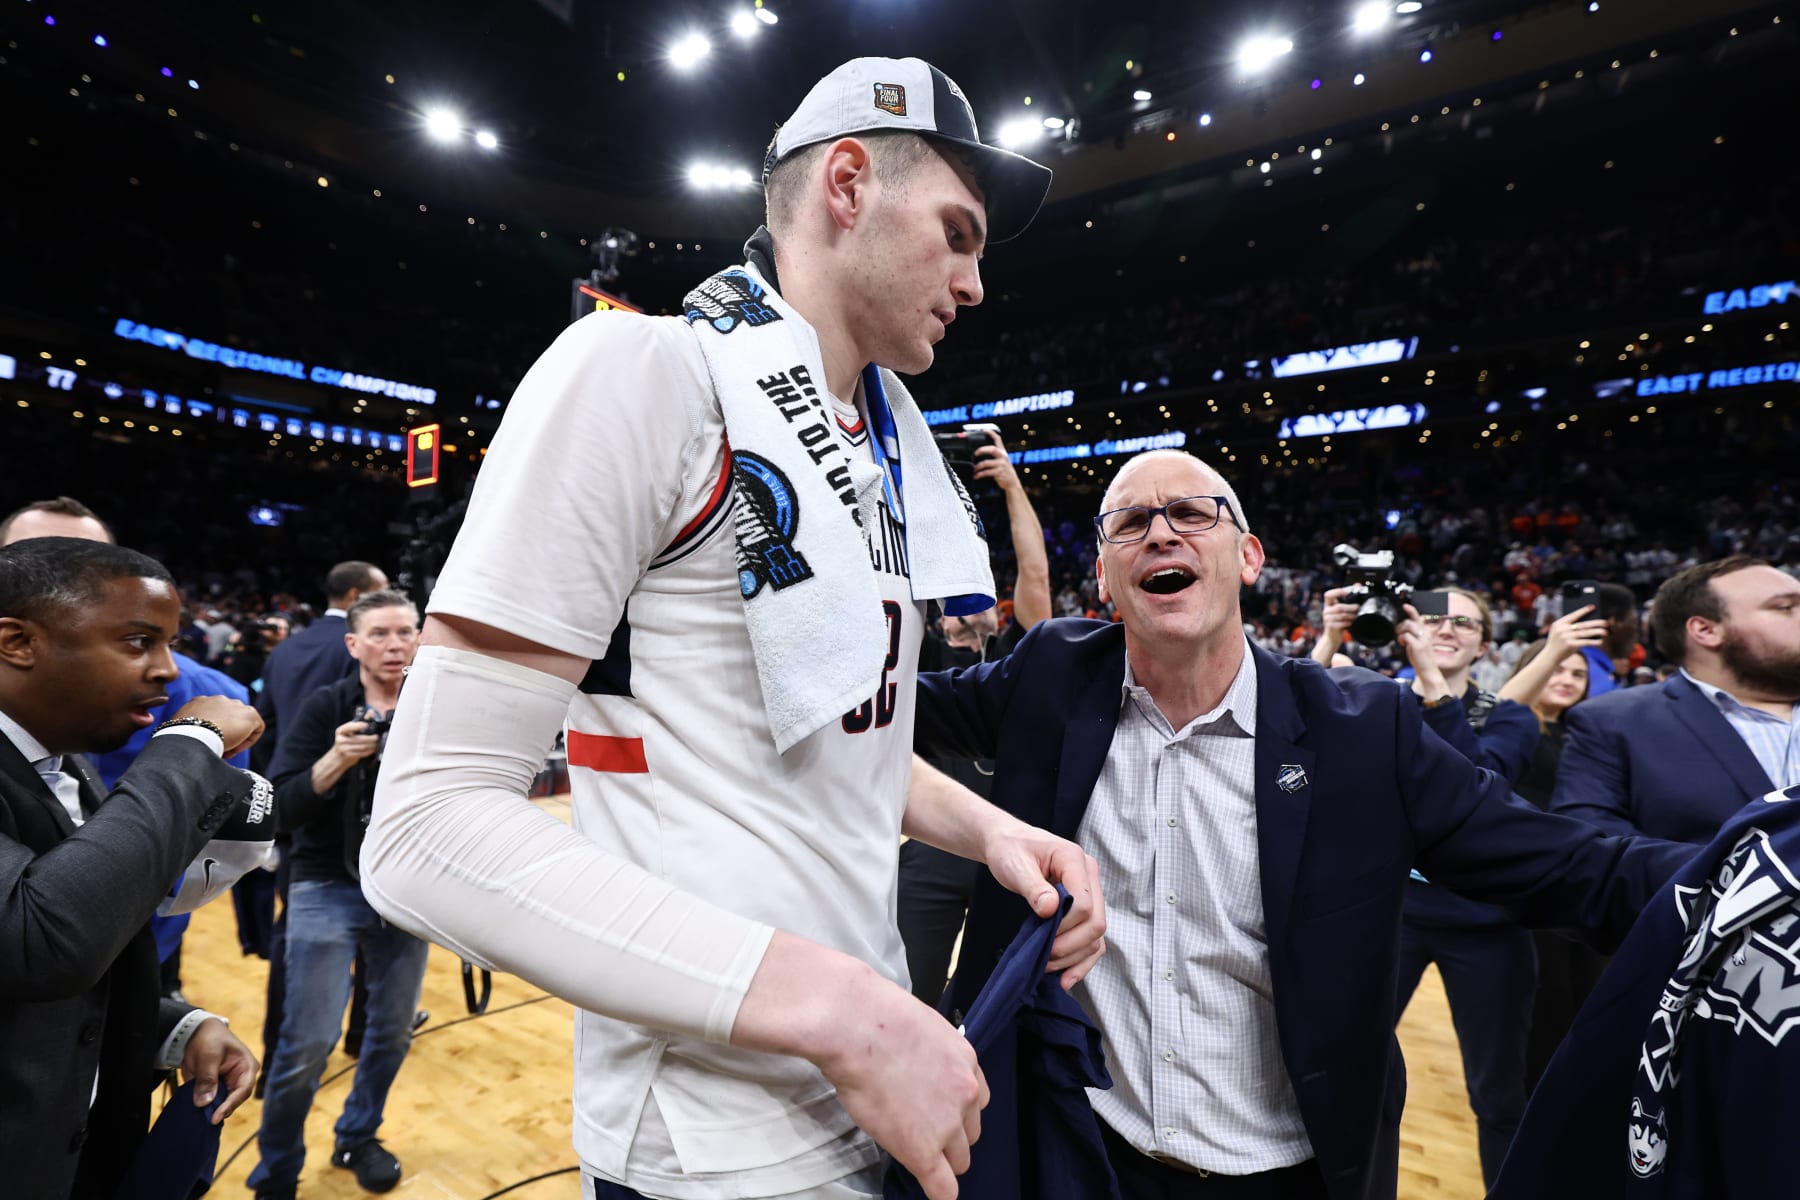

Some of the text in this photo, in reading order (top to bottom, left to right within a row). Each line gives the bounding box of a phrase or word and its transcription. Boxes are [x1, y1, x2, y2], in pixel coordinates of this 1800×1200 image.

[879, 89, 899, 97] FINAL
[879, 96, 899, 104] FOUR
[1704, 281, 1796, 314] EAST
[115, 318, 437, 405] EAST REGIONAL CHAMPIONS
[46, 366, 77, 391] 77
[1637, 373, 1704, 397] EAST
[756, 371, 811, 424] THE
[971, 390, 1074, 420] CHAMPIONS
[797, 423, 840, 466] TO
[1023, 443, 1092, 464] REGIONAL
[1094, 430, 1186, 456] CHAMPIONS
[769, 476, 787, 507] ELITE
[246, 781, 268, 824] FOUR
